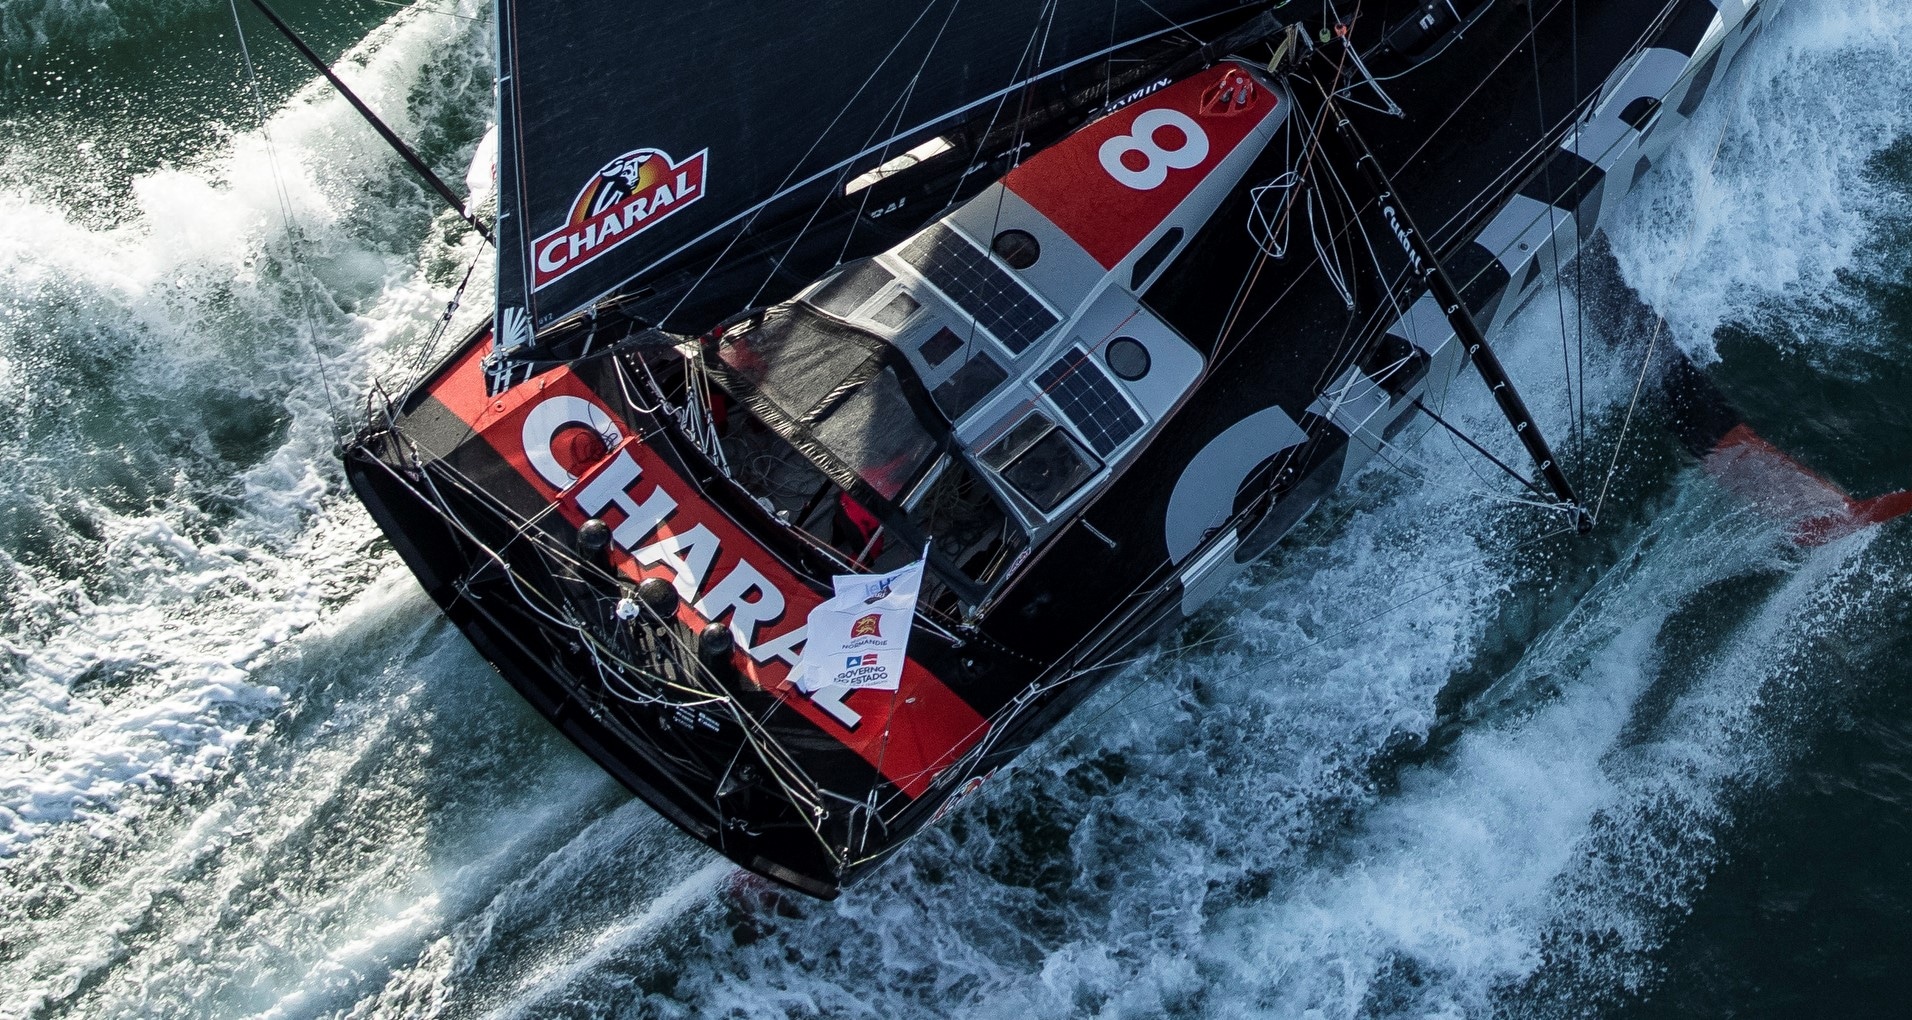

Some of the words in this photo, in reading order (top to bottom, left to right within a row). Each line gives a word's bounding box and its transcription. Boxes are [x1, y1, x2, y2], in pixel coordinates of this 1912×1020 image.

[1099, 108, 1210, 190] 8
[538, 170, 696, 273] CHARAL
[1379, 191, 1391, 202] 2
[1447, 304, 1459, 314] 5
[1469, 344, 1480, 354] 6
[1493, 381, 1505, 390] 7
[1517, 421, 1527, 432] 8
[1540, 460, 1551, 471] 9
[522, 396, 862, 728] CHARAL
[837, 666, 886, 679] GOVERNO
[841, 640, 888, 650] NORMANDIE
[851, 672, 888, 684] ESTADO
